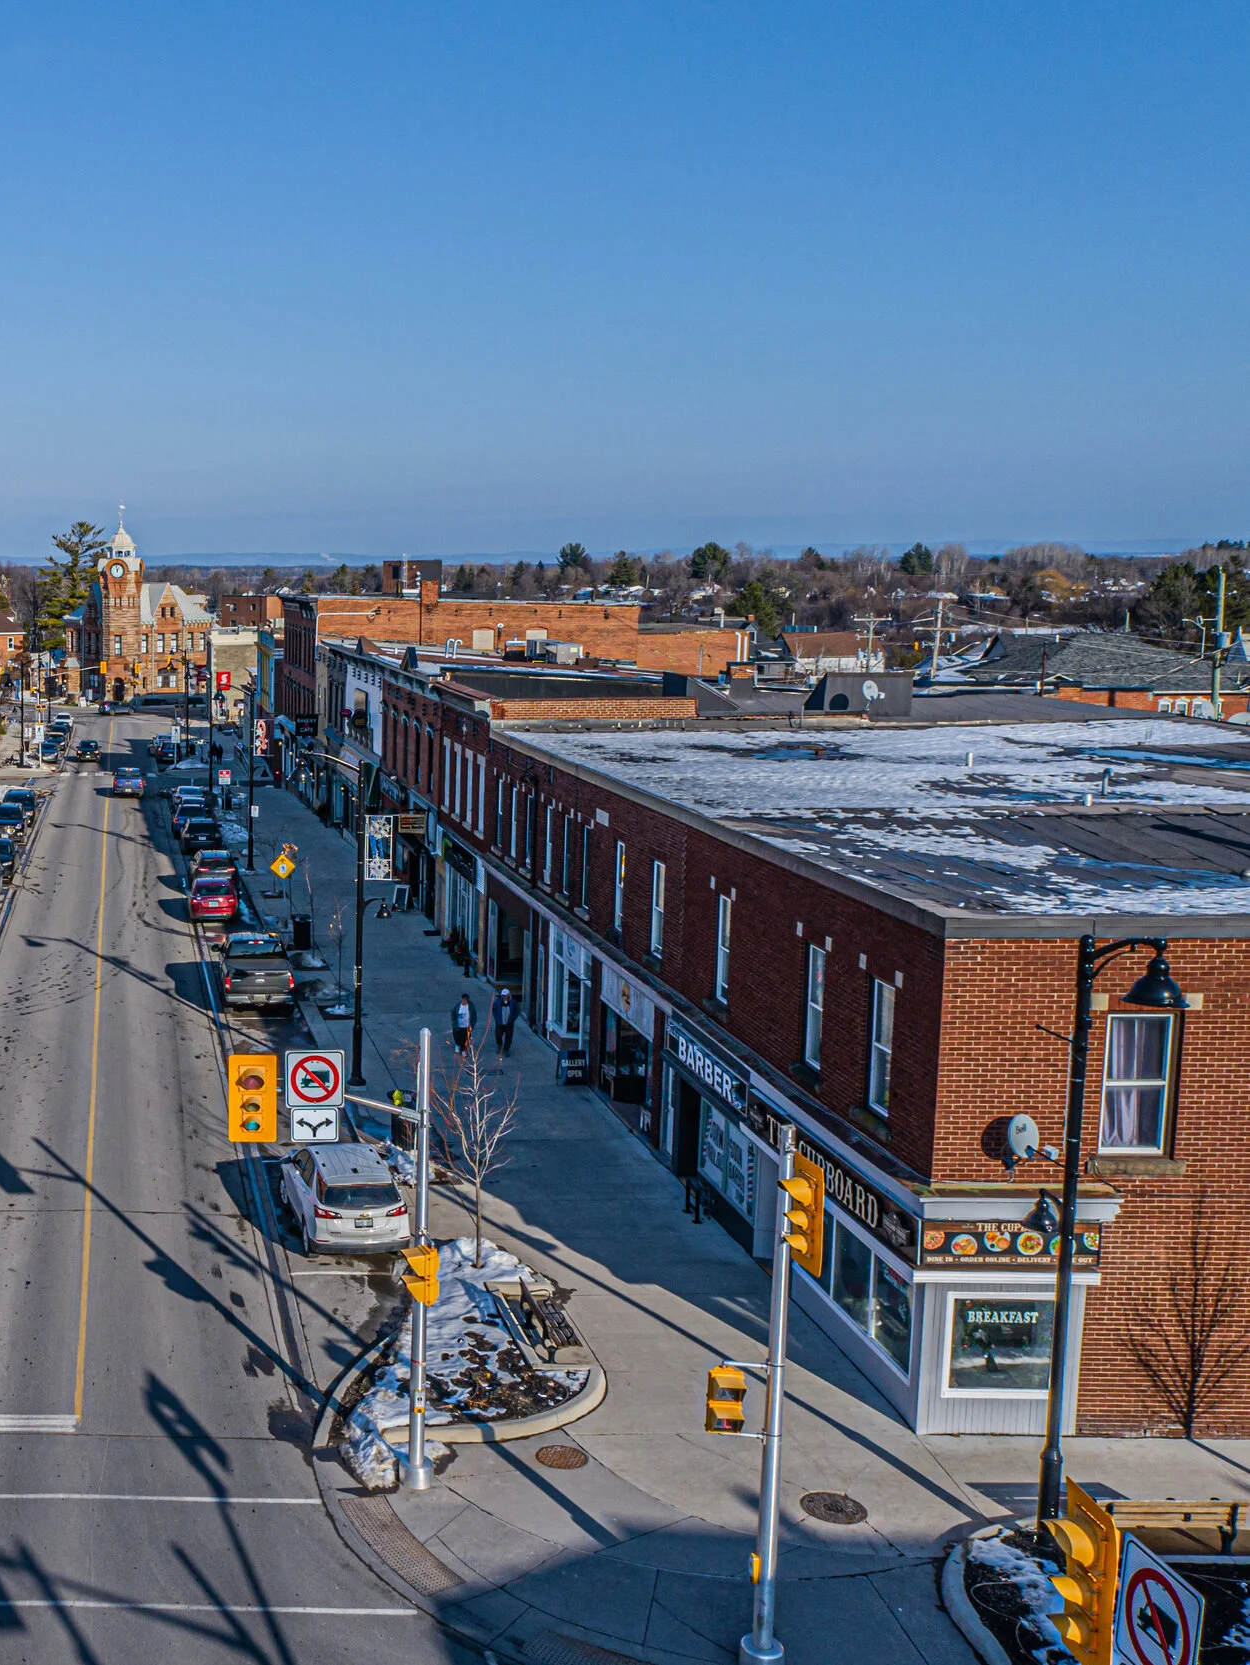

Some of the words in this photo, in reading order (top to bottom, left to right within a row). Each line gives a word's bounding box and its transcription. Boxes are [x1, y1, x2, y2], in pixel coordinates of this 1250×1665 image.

[561, 1059, 585, 1067] GALLERY
[567, 1069, 583, 1078] OPEN
[678, 1035, 732, 1103] BARBER
[1015, 1122, 1027, 1135] Bell
[976, 1222, 999, 1232] THE
[967, 1310, 1039, 1324] BREAKFAST
